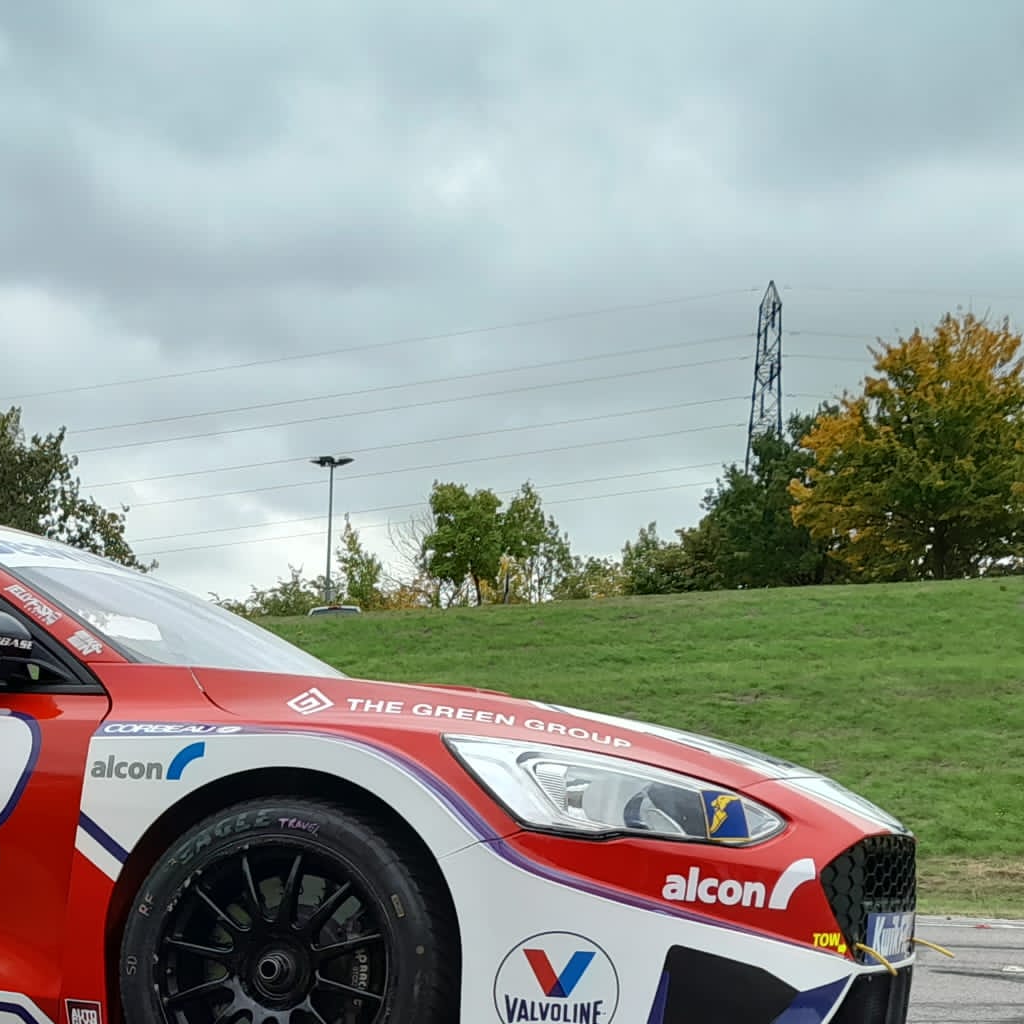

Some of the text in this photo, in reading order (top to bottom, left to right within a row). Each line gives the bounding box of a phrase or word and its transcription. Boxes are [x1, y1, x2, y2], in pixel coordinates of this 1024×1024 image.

[103, 723, 216, 734] CORBEAU
[346, 698, 632, 748] THE GREEN GROUP
[90, 754, 163, 780] alcon
[661, 866, 766, 909] alcon
[813, 932, 841, 948] TOW
